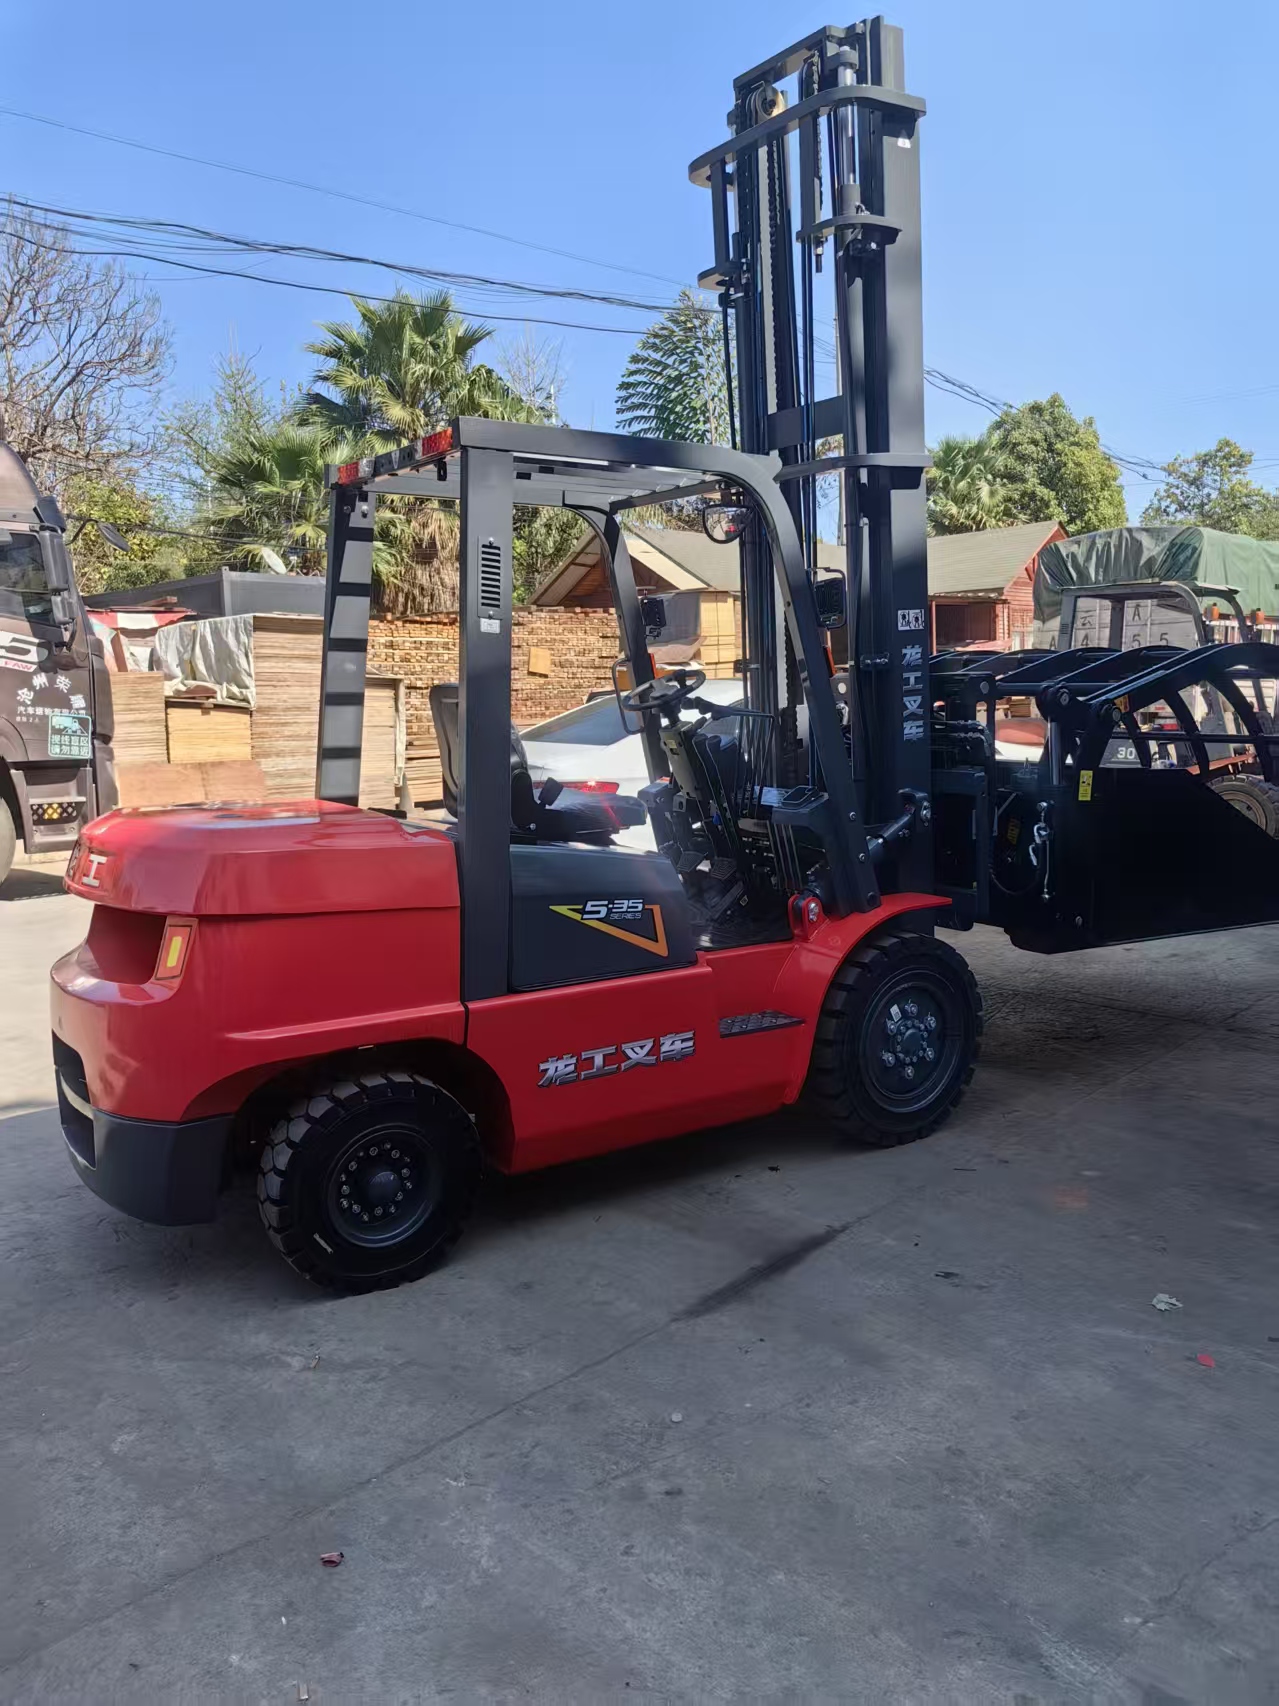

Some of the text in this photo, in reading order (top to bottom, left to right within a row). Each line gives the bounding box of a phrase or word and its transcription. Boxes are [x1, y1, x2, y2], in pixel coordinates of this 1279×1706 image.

[1117, 747, 1136, 759] 30
[609, 912, 642, 920] SERIES
[537, 1030, 696, 1087] 龙工叉车
